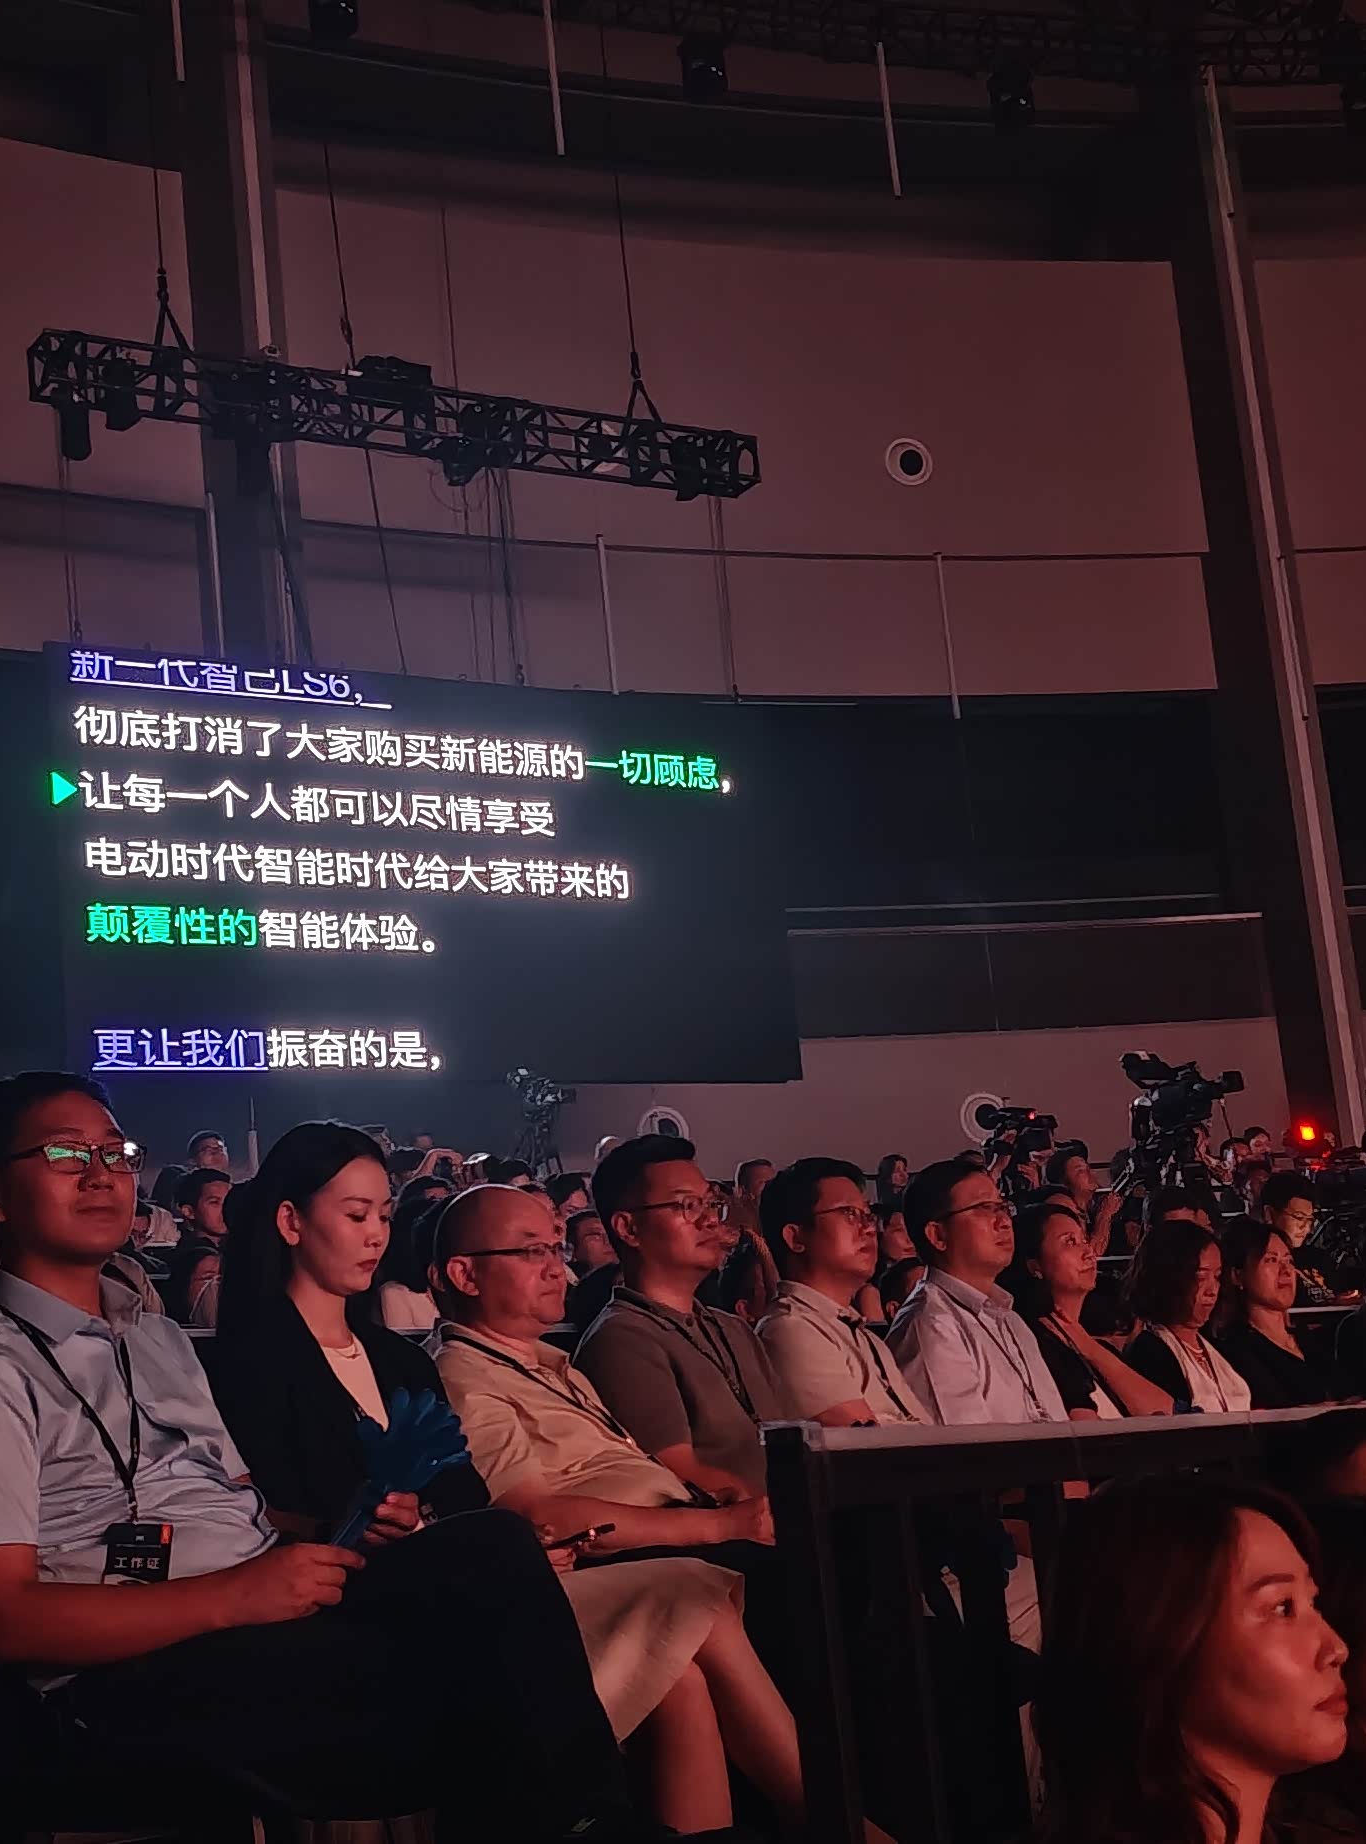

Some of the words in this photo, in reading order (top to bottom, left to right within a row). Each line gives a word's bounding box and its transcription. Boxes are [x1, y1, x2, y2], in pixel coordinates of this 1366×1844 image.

[73, 705, 731, 793] 彻底打消了大家购买新能源的一切顾虑，
[78, 770, 555, 837] 让每一个人都可以尽情享受
[84, 837, 629, 899] 电动时代智能时代给大家带来的
[86, 902, 436, 953] 颠覆性的智能体验。
[92, 1028, 441, 1071] 更让我们振奋的是，
[114, 1556, 161, 1570] 工作证
